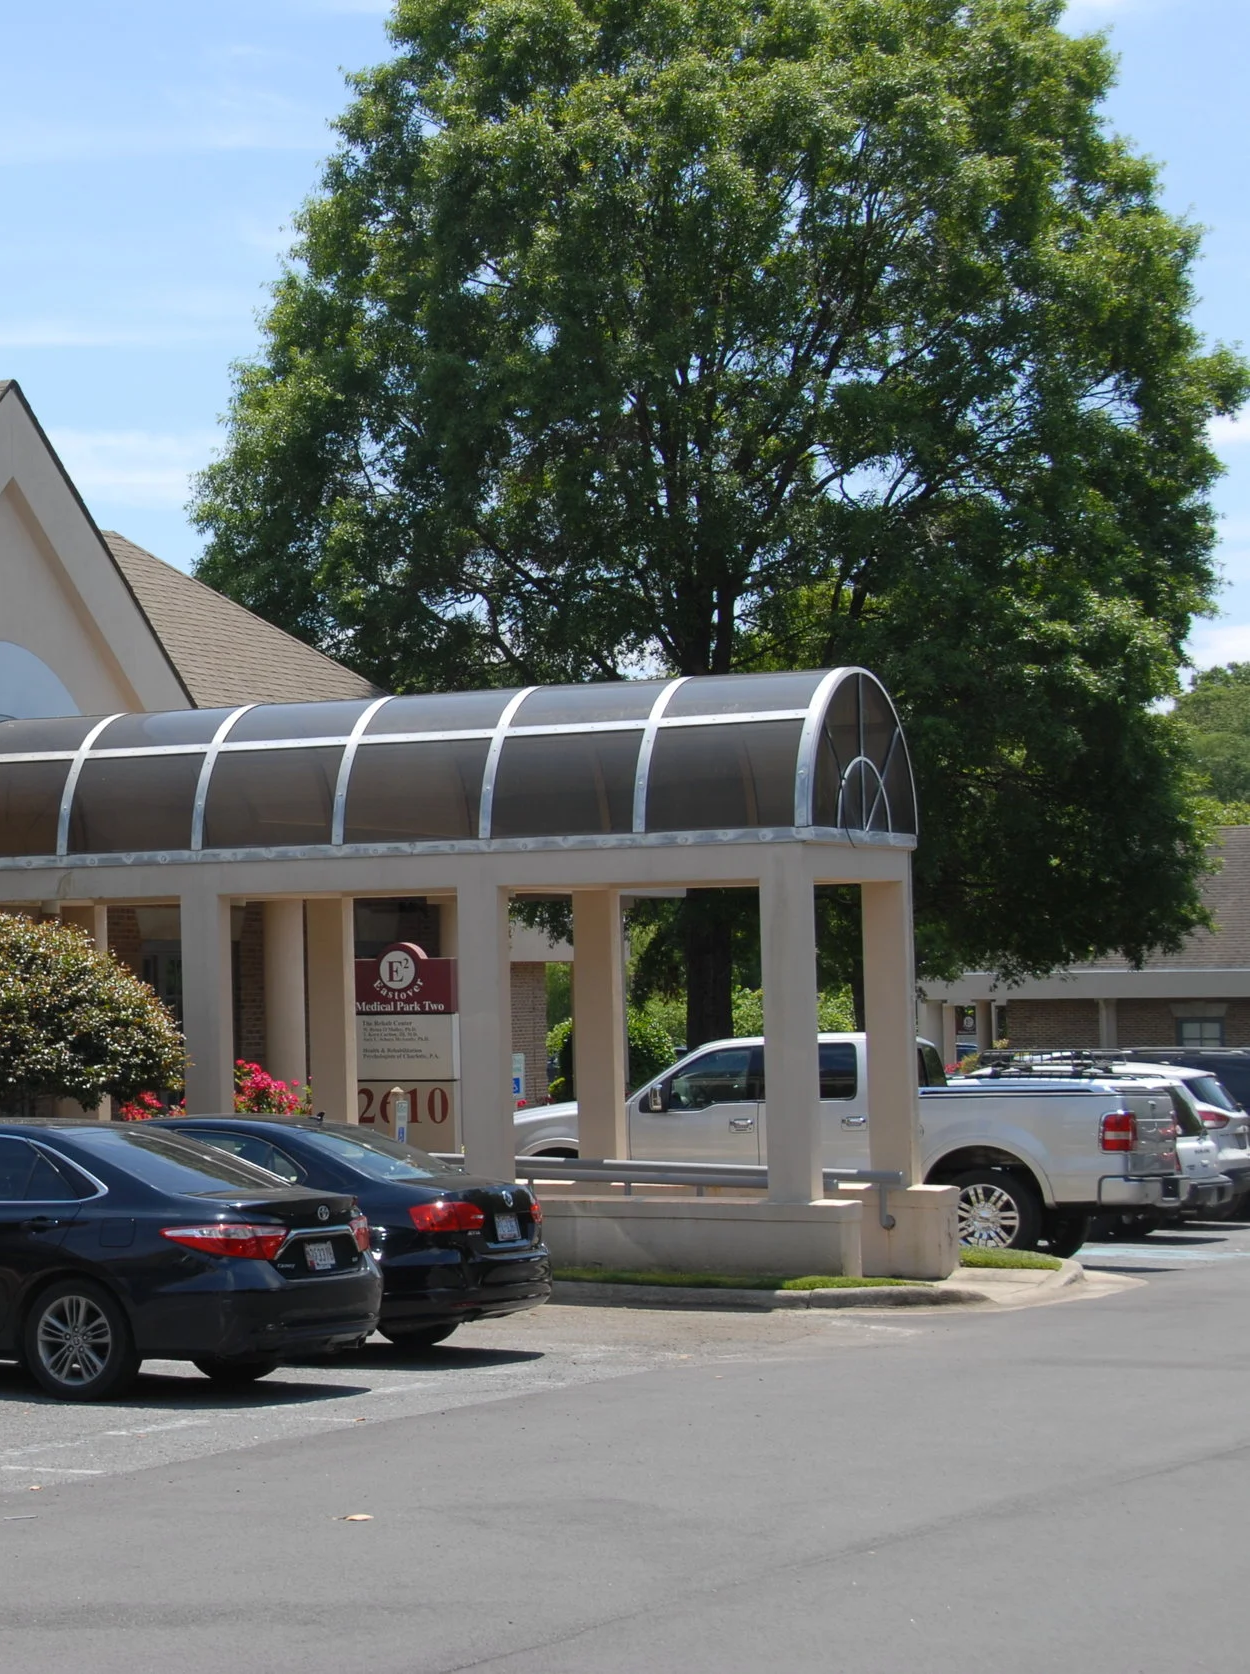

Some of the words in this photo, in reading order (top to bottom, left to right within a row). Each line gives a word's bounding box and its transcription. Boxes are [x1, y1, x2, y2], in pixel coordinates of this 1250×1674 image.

[373, 978, 424, 1000] Eastover
[356, 1001, 394, 1012] Medical
[396, 1001, 421, 1012] Park
[423, 1001, 445, 1011] Two
